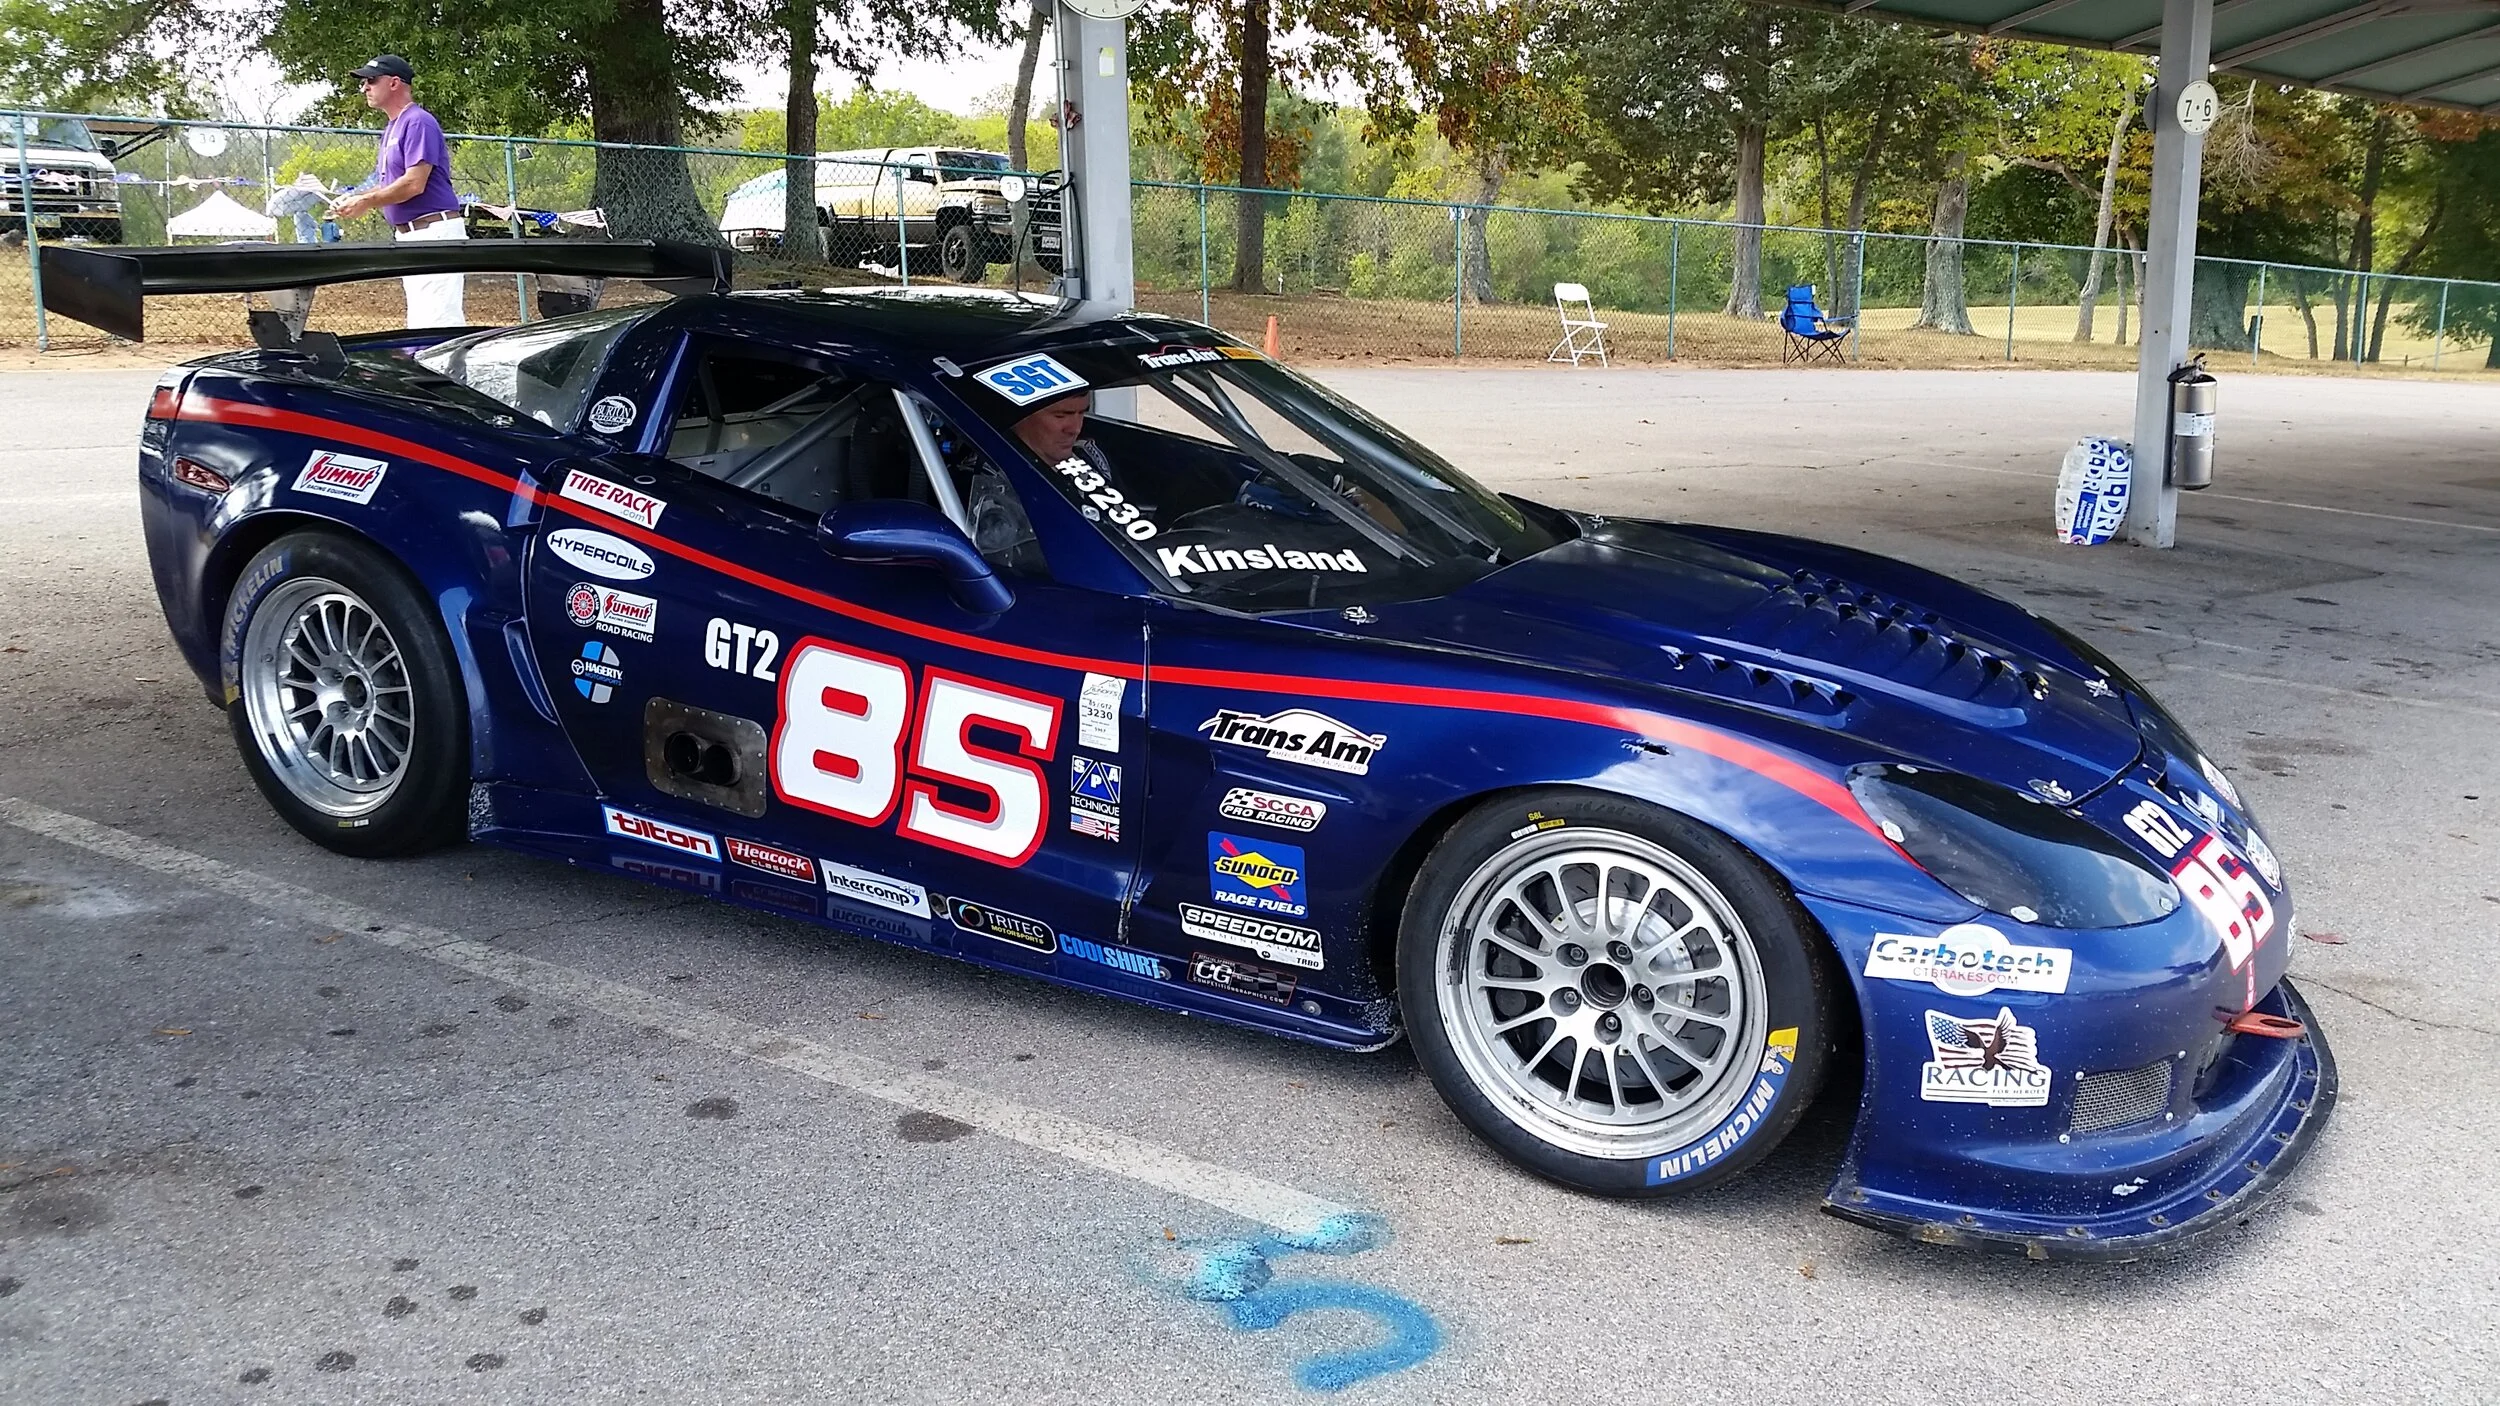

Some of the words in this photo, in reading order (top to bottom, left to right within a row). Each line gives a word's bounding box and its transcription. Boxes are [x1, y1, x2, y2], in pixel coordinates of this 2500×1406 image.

[1137, 353, 1193, 369] Trans
[1186, 348, 1223, 362] Am
[989, 359, 1073, 397] SGT
[306, 484, 327, 492] RACING
[326, 487, 360, 498] EQUIPMENT
[569, 472, 611, 498] TIRE
[606, 487, 658, 526] RACK
[1055, 456, 1158, 541] #3230
[620, 508, 646, 522] .com
[550, 534, 653, 575] HYPERCOILS
[1156, 543, 1368, 578] Kinsland
[583, 584, 595, 594] CAR
[223, 555, 283, 657] MICHELIN
[596, 622, 621, 635] ROAD
[621, 627, 653, 643] RACING
[704, 616, 781, 683] GT2
[584, 672, 622, 686] MOTORSPORTS
[585, 661, 623, 681] HAGERTY
[1087, 706, 1113, 721] 3230
[770, 636, 1063, 867] 85
[1211, 711, 1307, 752] Trans
[1304, 730, 1372, 765] Am
[1070, 795, 1120, 817] TECHNIQUE
[1223, 804, 1255, 819] PRO
[1256, 810, 1313, 829] RACING
[1253, 796, 1316, 819] SCCA
[612, 812, 713, 855] tilton
[2122, 800, 2194, 859] GT2
[731, 841, 809, 872] Heacock
[751, 858, 799, 877] CLASSIC
[1218, 858, 1296, 884] SUNOCO
[828, 870, 910, 907] Intercomp
[1214, 889, 1257, 908] RACE
[1257, 897, 1306, 916] FUELS
[2171, 830, 2273, 975] 85
[984, 910, 1044, 939] TRITEC
[991, 924, 1044, 945] MOTORSPORTS
[1186, 908, 1317, 949] SPEEDCOM
[1058, 932, 1162, 980] COOLSHIRT
[1296, 957, 1320, 968] TRBO
[1876, 938, 2054, 976] Carbotech
[1196, 960, 1233, 984] CG
[1913, 966, 2019, 985] CTBRAKES.COM
[1926, 1065, 2047, 1088] RACING
[1660, 1077, 1775, 1180] MICHELIN
